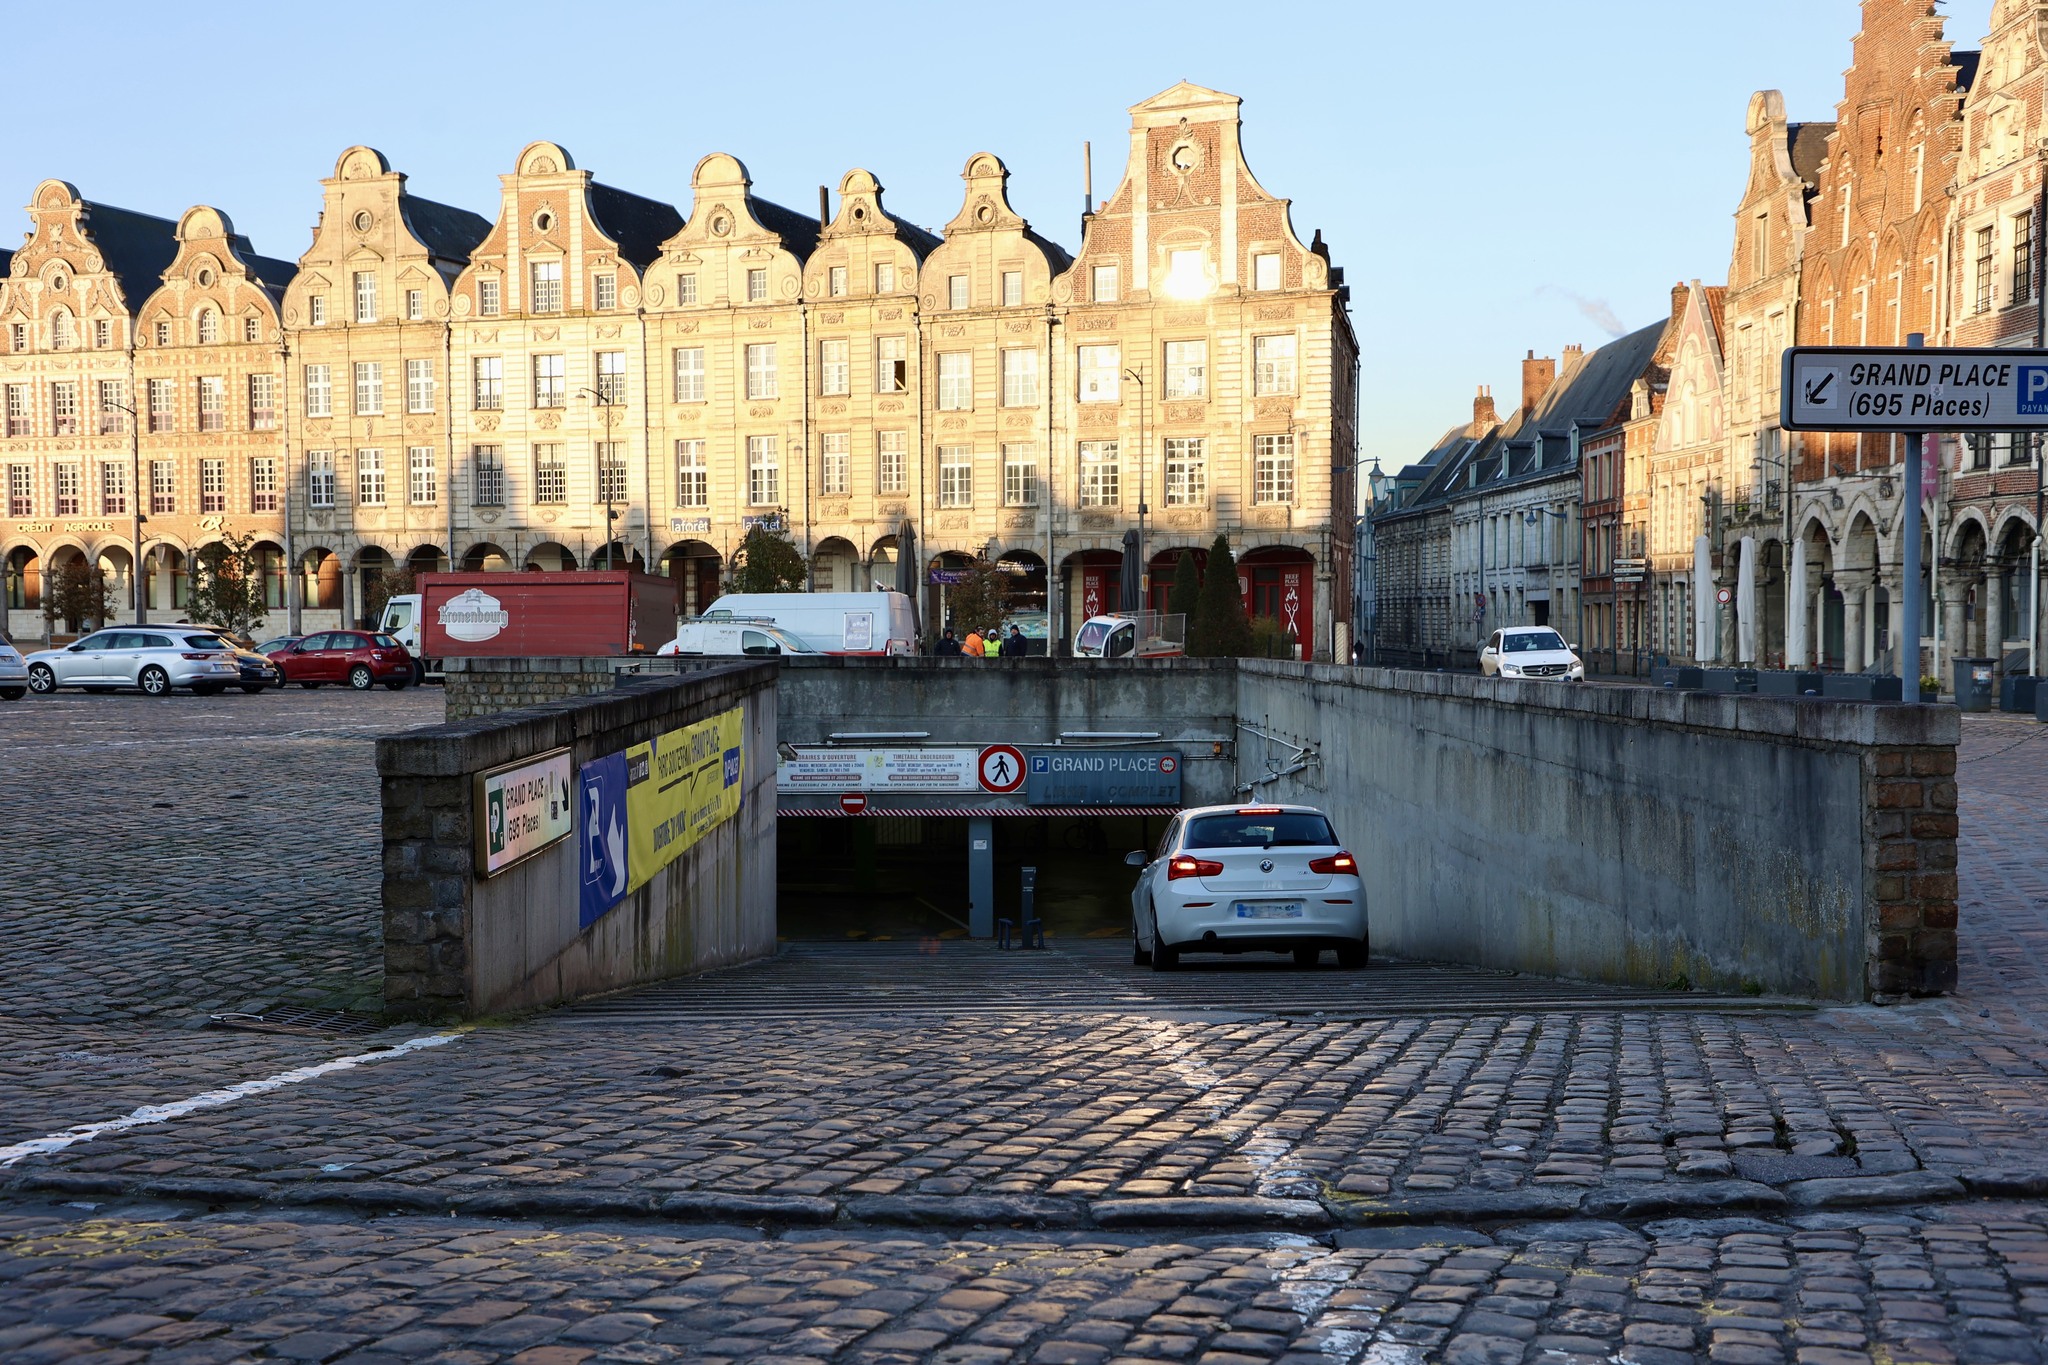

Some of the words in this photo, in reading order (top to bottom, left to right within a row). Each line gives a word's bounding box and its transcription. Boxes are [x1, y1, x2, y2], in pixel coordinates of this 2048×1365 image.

[1850, 363, 1931, 386] GRAND
[1939, 364, 2011, 387] PLACE
[2028, 370, 2048, 401] P
[1849, 391, 1903, 418] (695
[1911, 392, 1990, 418] Places)
[2021, 404, 2048, 413] PAYAN
[17, 521, 52, 533] CRÉDIT
[64, 522, 113, 532] AGRICOLE
[671, 519, 709, 533] laforêt
[438, 606, 508, 628] Kronenbourg
[1036, 759, 1045, 771] P
[1052, 757, 1104, 772] GRAND
[1109, 757, 1157, 772] PLACE
[505, 783, 525, 810] GRAND
[528, 777, 544, 802] PLACE
[1107, 785, 1176, 798] COMPLET
